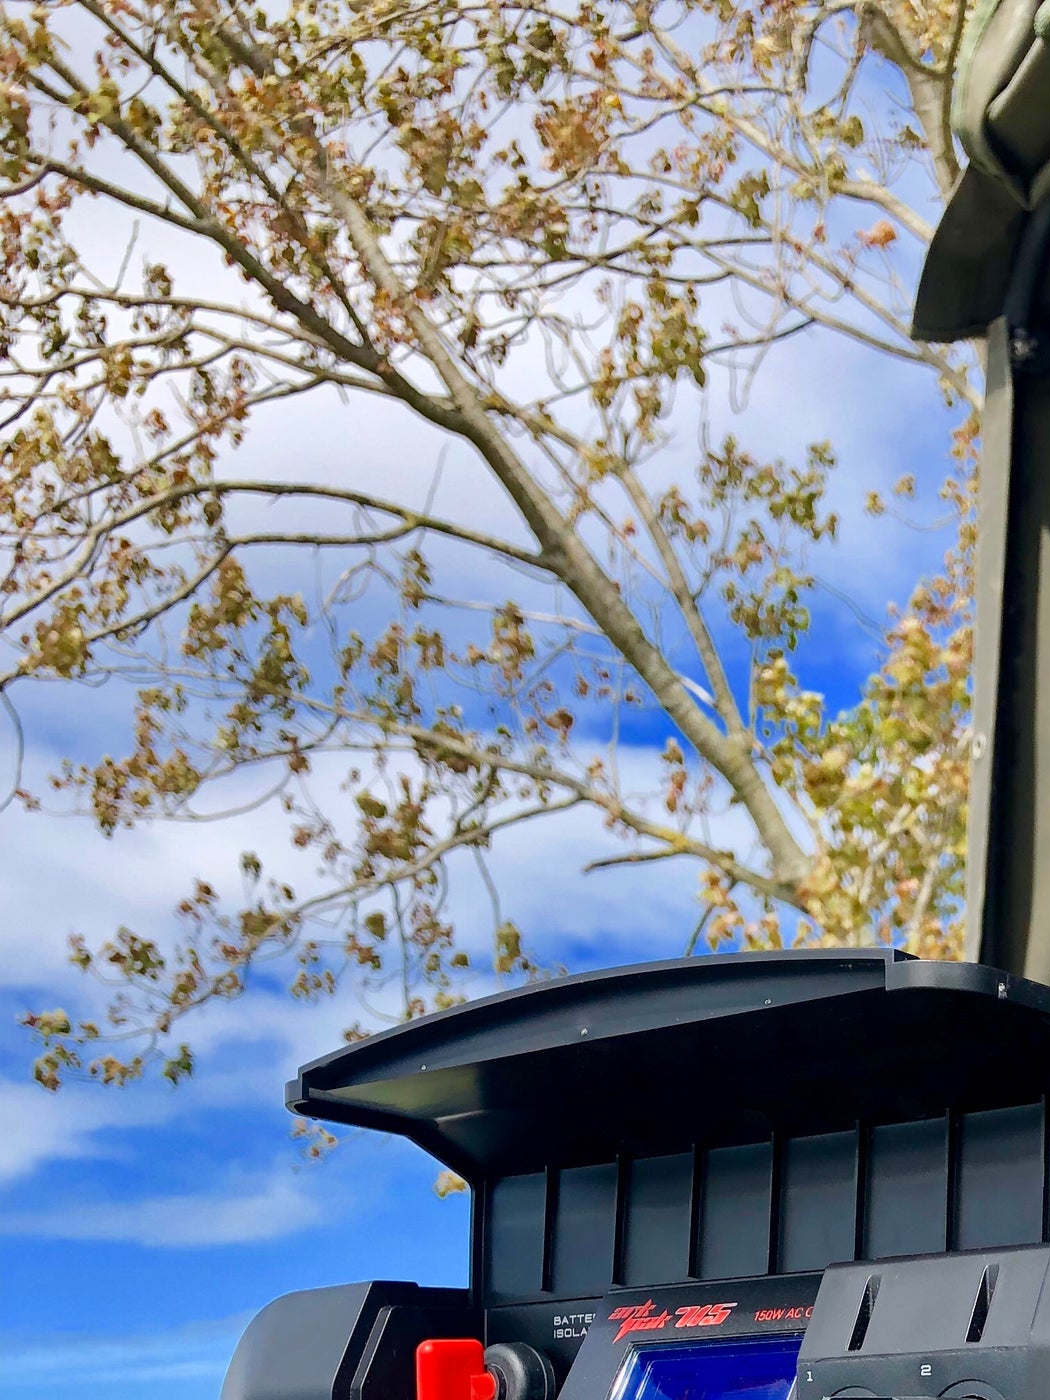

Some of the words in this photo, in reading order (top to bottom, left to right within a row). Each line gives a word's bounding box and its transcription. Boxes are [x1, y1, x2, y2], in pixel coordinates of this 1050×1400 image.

[754, 1307, 783, 1322] 150W
[785, 1305, 804, 1319] AC
[553, 1327, 591, 1339] ISOLA
[920, 1364, 932, 1376] 2
[806, 1371, 814, 1382] 1
